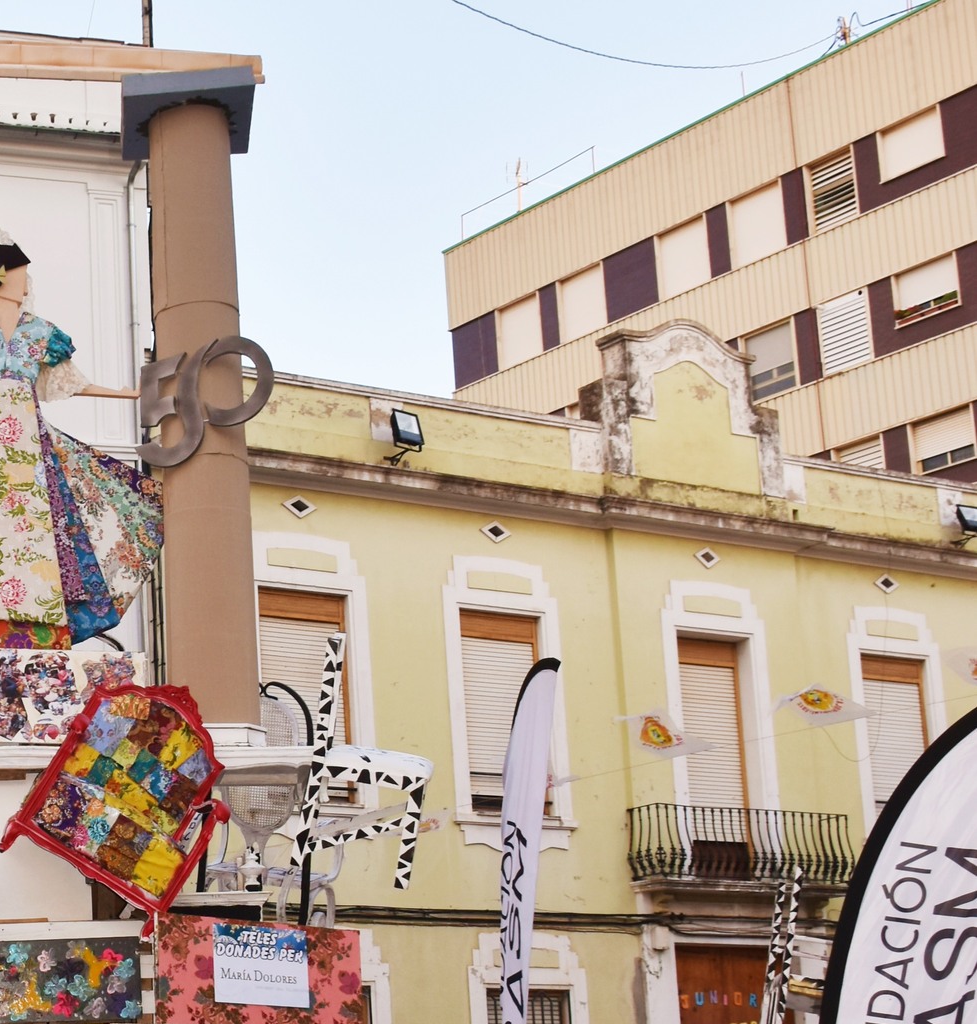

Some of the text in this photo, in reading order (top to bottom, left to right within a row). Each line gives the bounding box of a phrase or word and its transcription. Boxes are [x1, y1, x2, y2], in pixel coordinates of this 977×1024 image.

[135, 336, 274, 467] 50
[240, 930, 278, 946] TELES
[215, 942, 304, 964] DONADES PER
